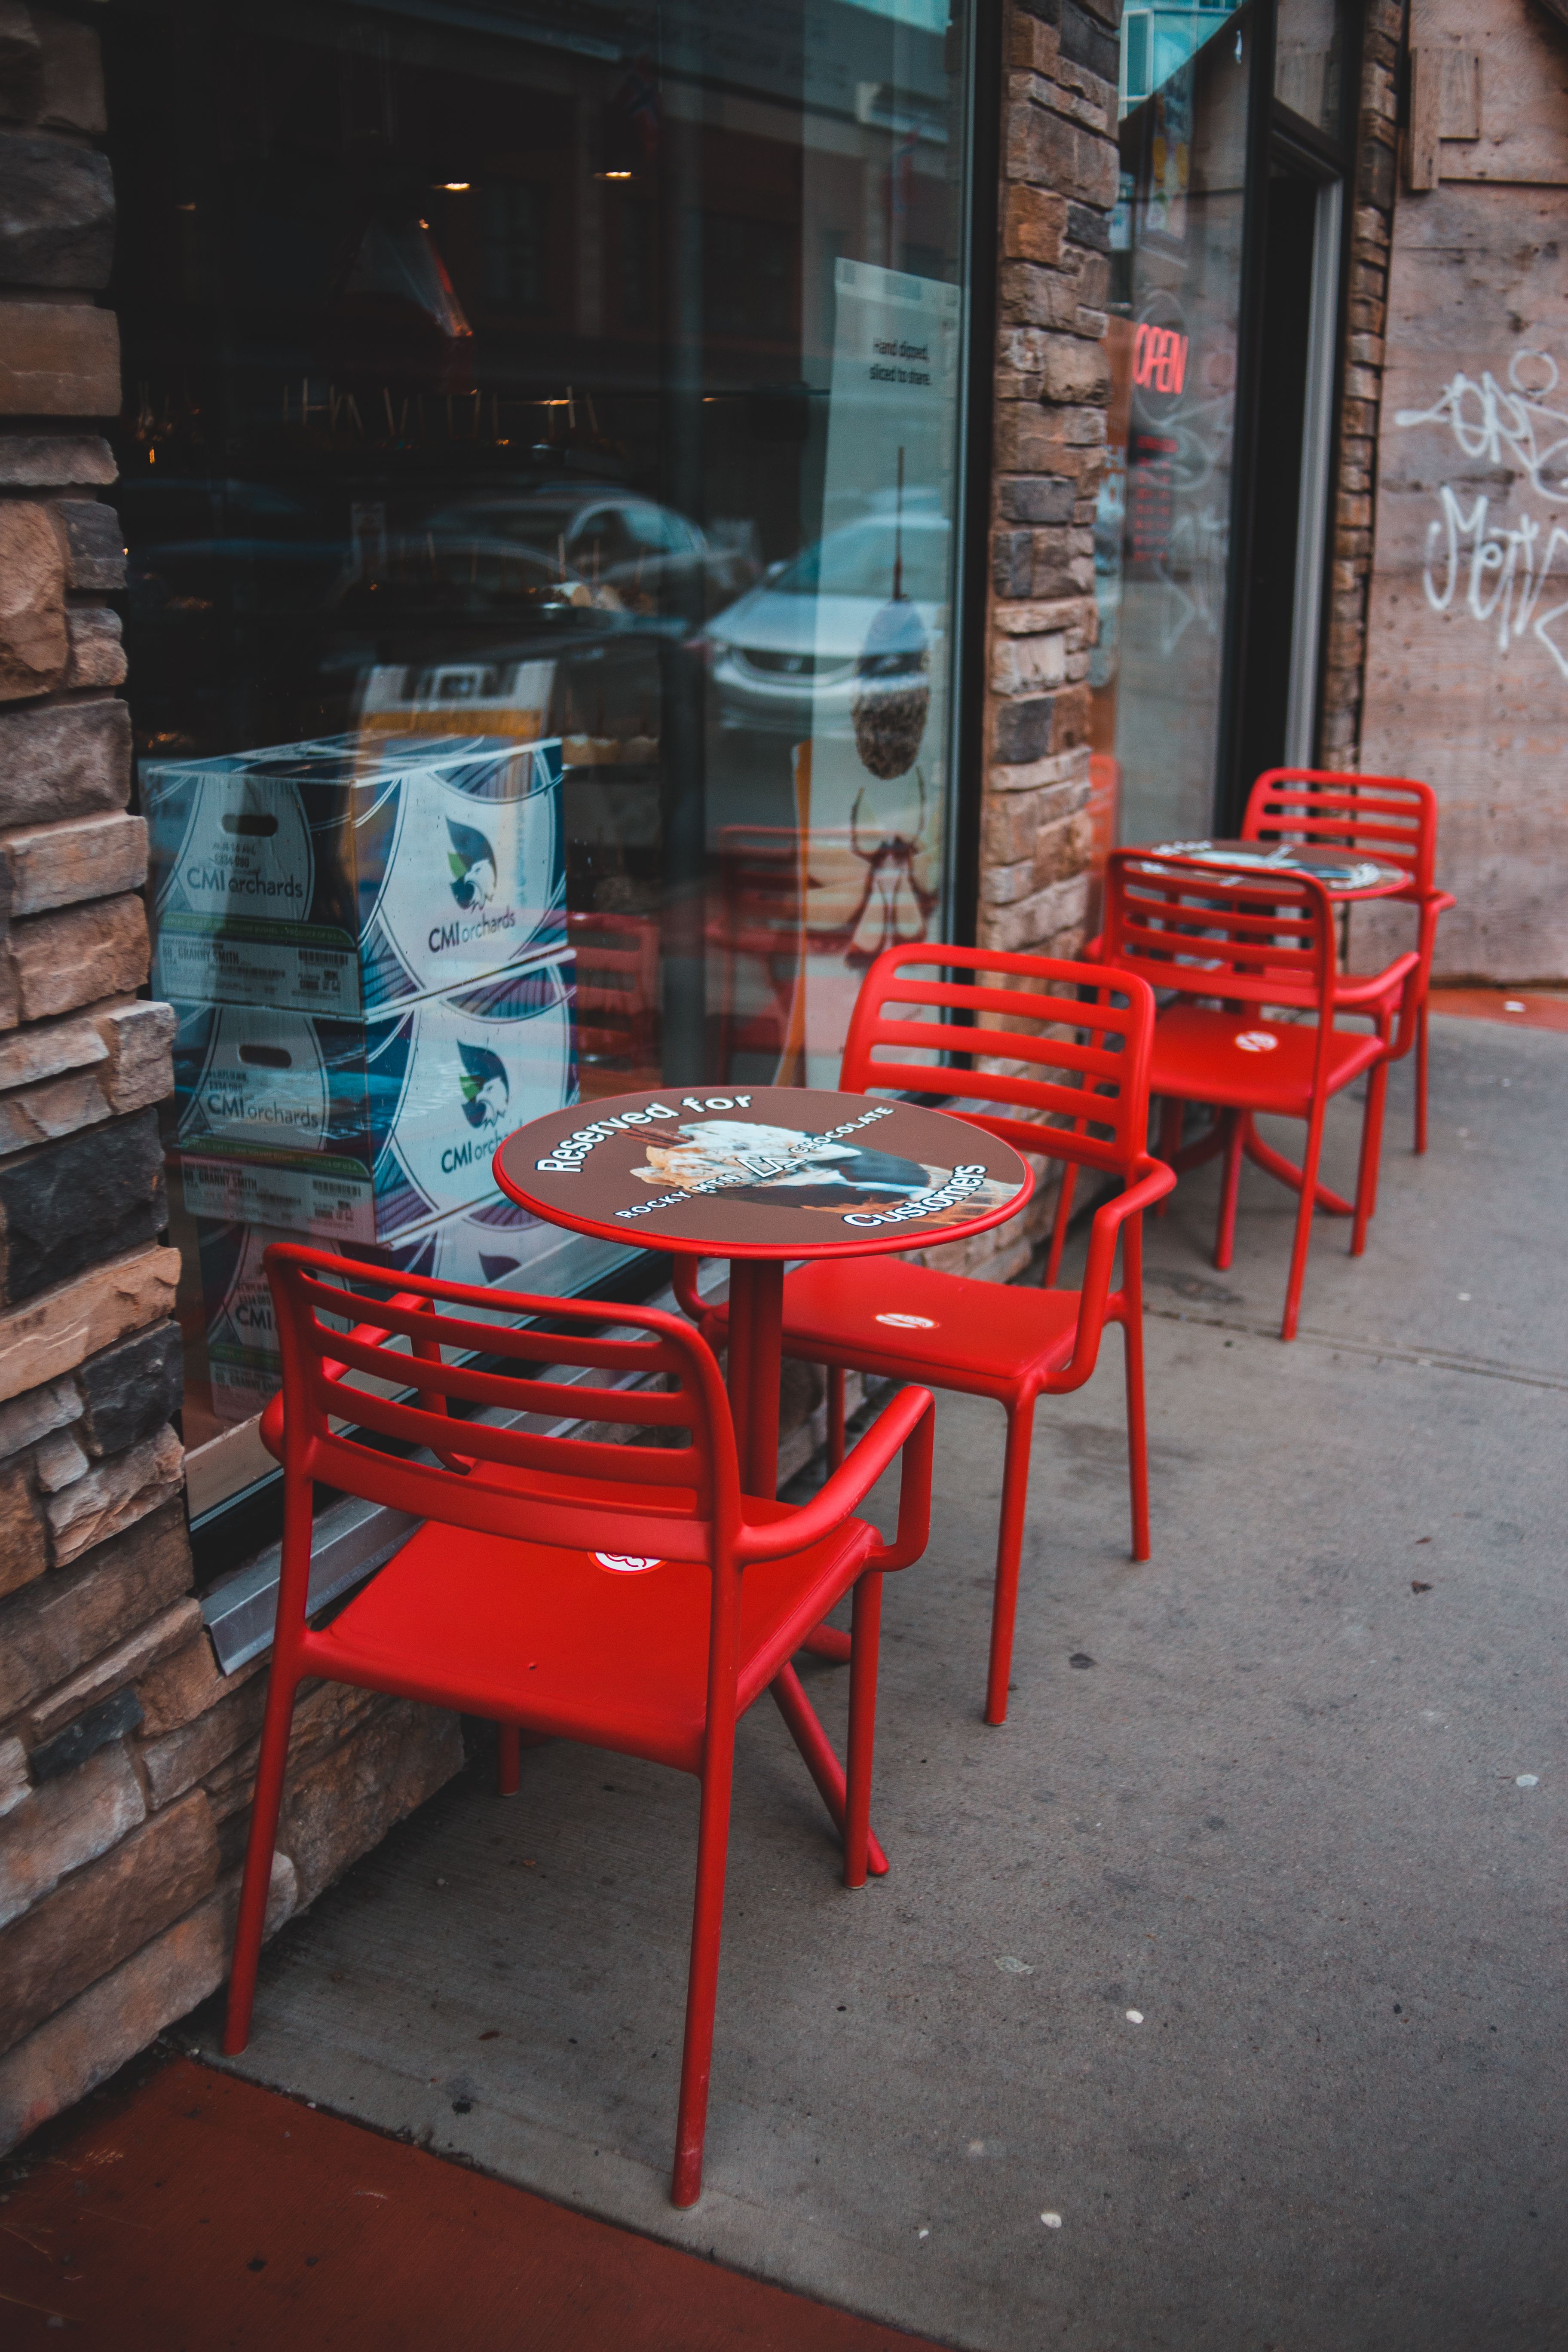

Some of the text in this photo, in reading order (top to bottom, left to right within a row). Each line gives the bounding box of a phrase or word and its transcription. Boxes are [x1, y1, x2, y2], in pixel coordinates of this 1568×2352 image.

[1133, 323, 1188, 395] OPEN
[187, 867, 303, 898] CMI orchards
[429, 905, 516, 953] CMI orchards
[178, 946, 210, 962] GRANNY
[212, 949, 239, 965] SMITH
[207, 1093, 318, 1128] CMI orchards
[535, 1094, 753, 1173] Reserved for
[441, 1140, 472, 1173] CMI
[613, 1106, 894, 1219] ROCKY MTN CHOCOLATE
[198, 1172, 230, 1188] GRANNY
[232, 1176, 257, 1191] SMITH
[842, 1164, 988, 1227] Customers
[236, 1304, 272, 1331] CMI
